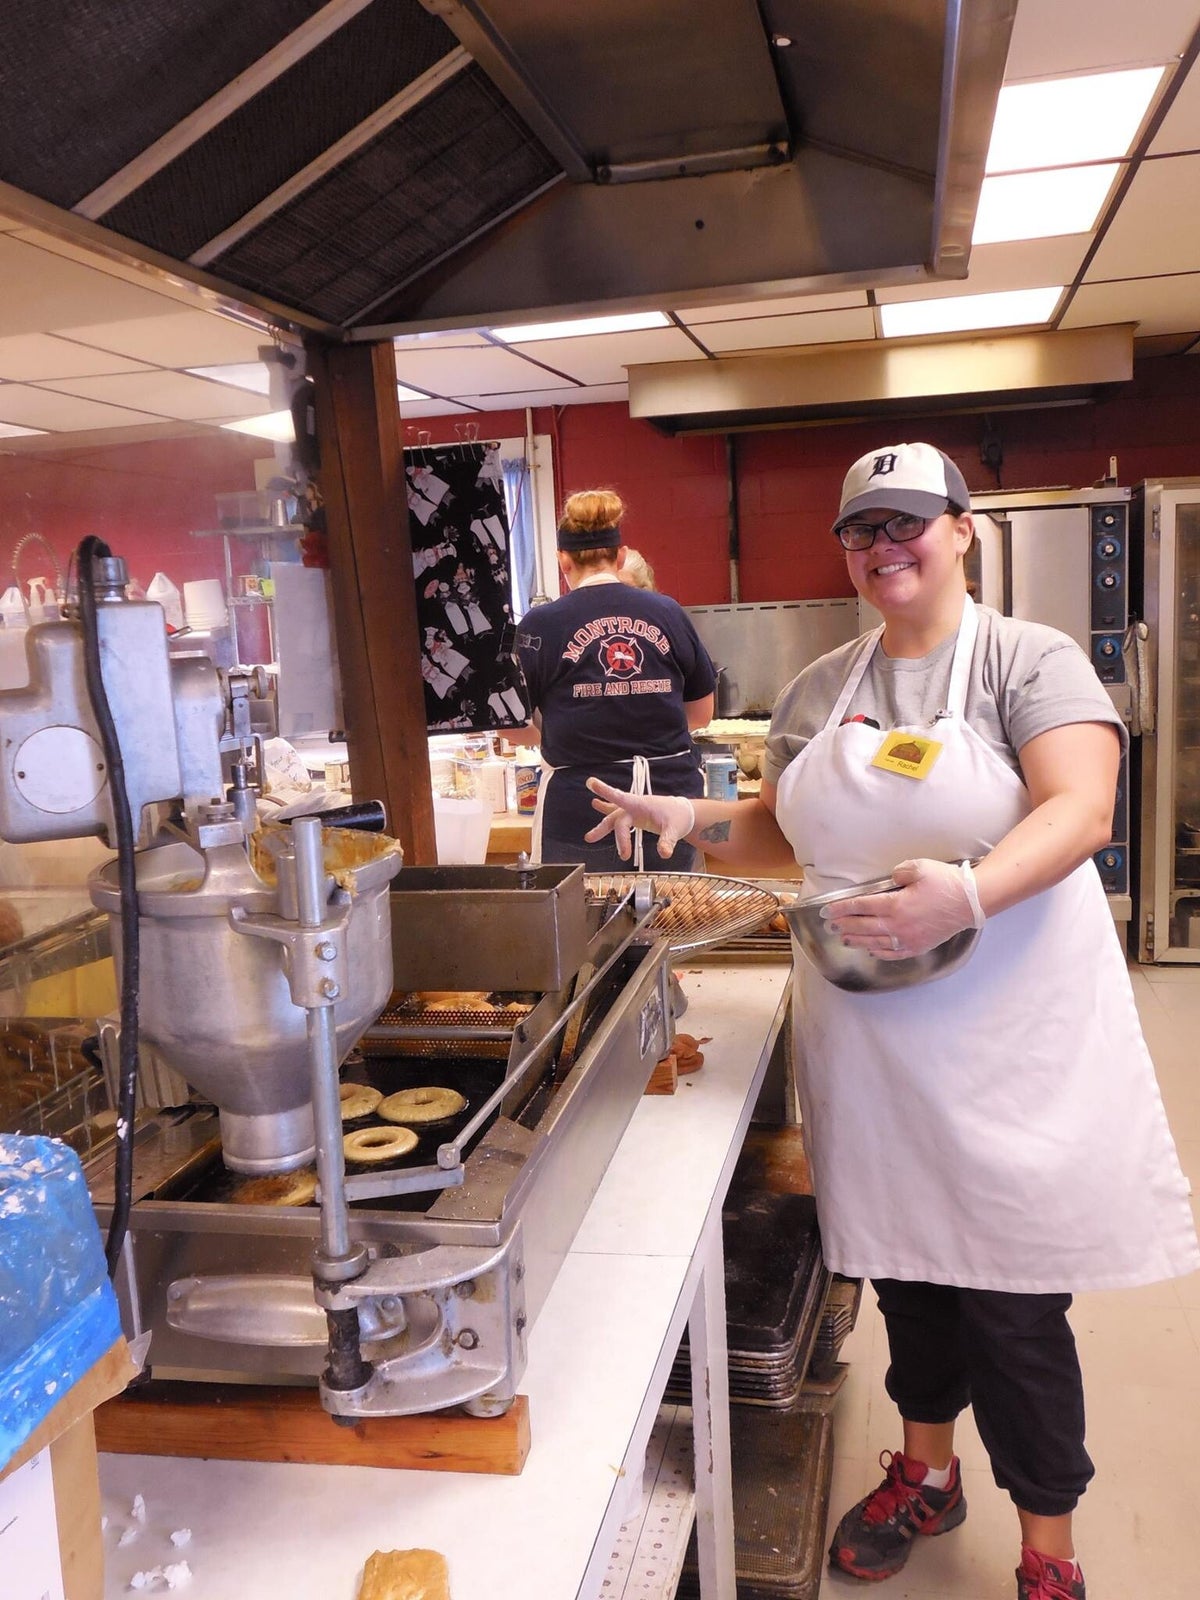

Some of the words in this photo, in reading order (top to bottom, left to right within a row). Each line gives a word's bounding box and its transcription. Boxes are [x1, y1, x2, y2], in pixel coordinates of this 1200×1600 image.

[868, 453, 898, 481] D
[562, 616, 671, 663] MONTROSE
[573, 683, 602, 698] FIRE
[604, 681, 629, 697] AND
[630, 679, 671, 694] RESCUE
